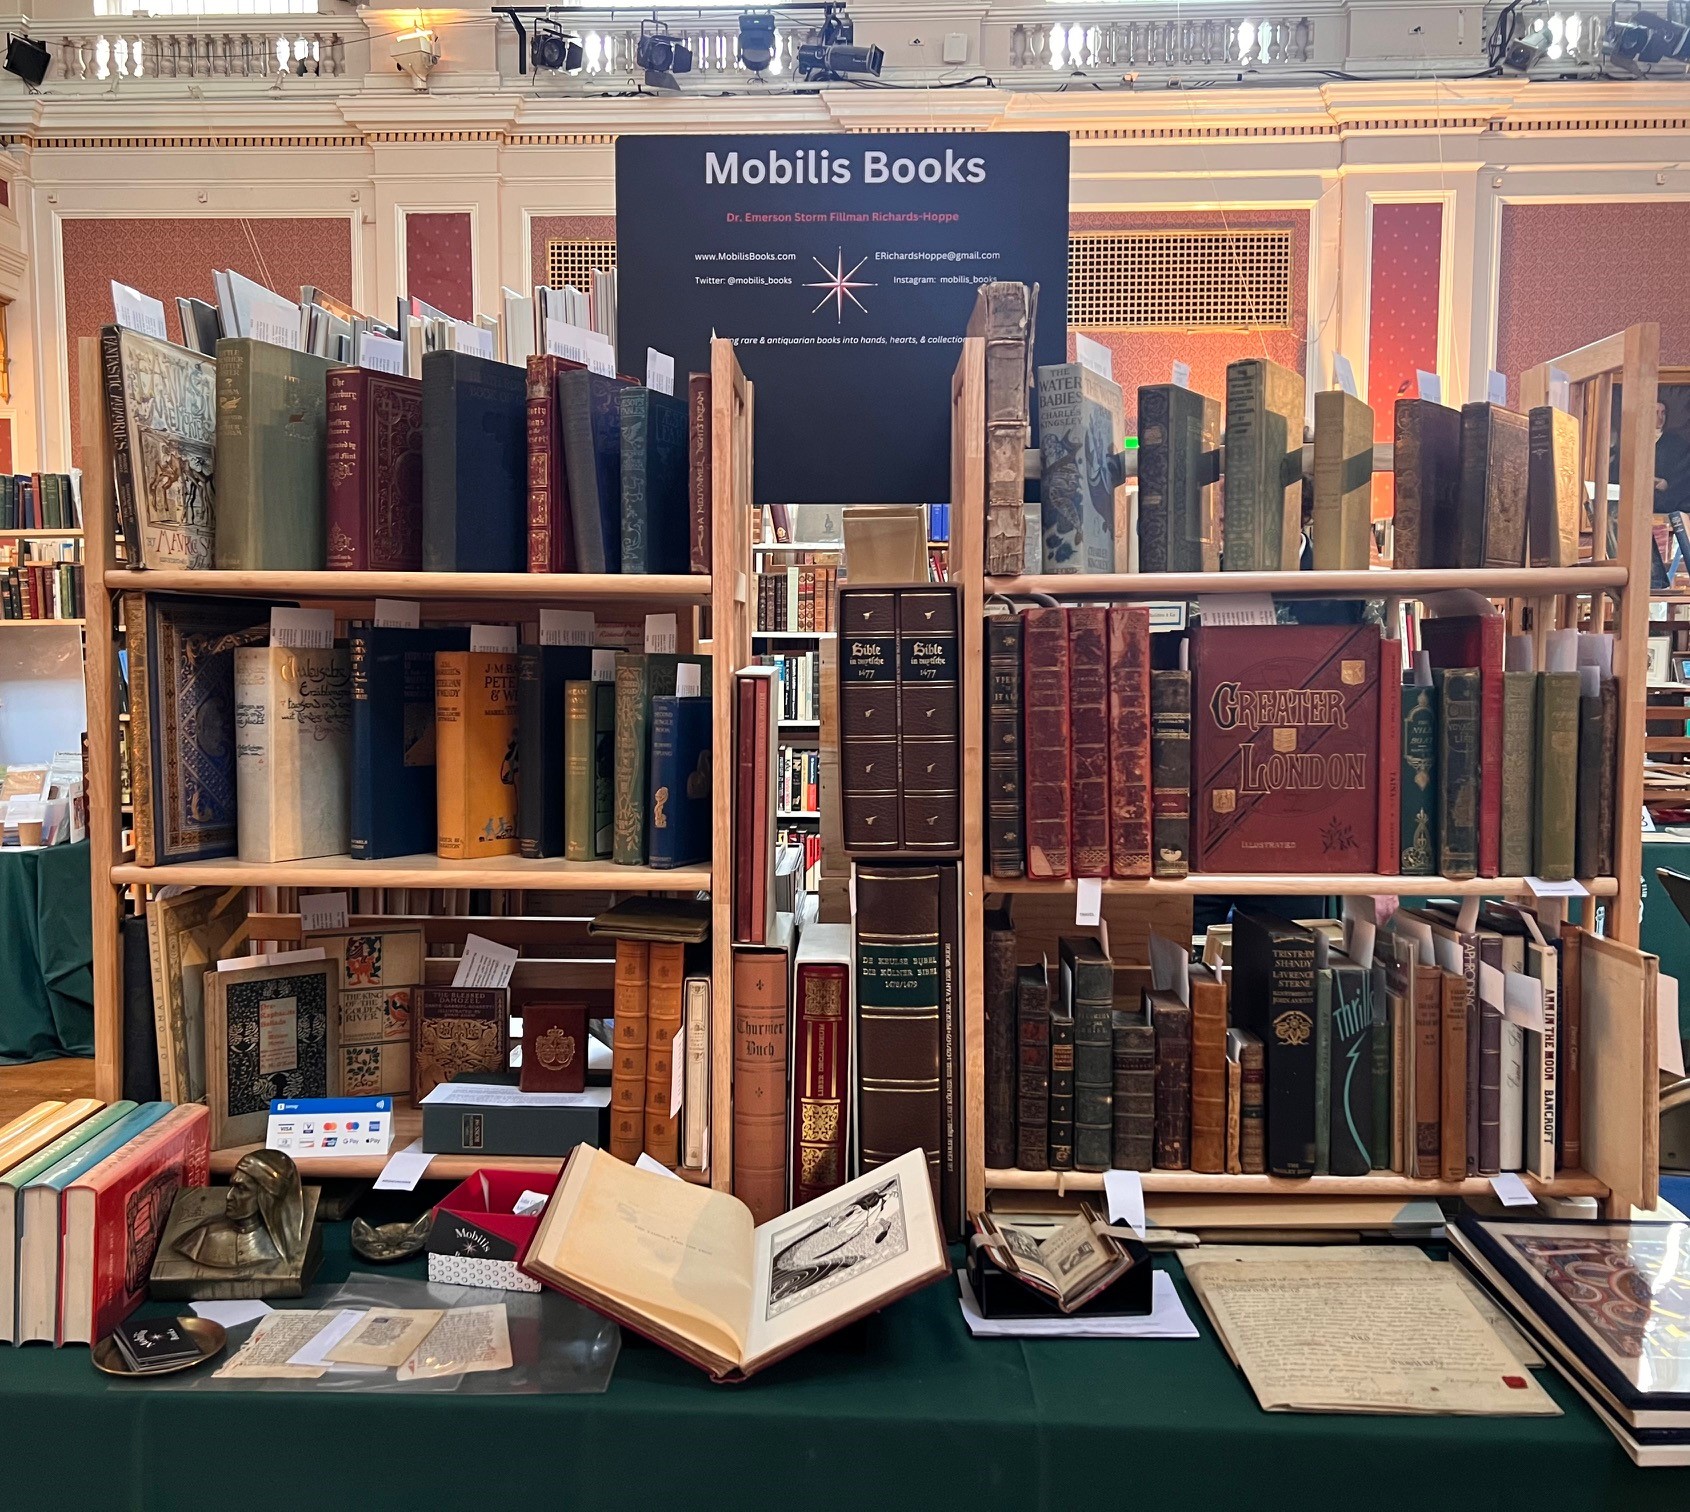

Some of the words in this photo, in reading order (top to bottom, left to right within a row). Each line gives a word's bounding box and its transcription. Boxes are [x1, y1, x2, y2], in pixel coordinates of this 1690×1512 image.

[705, 149, 851, 184] Mobilis
[864, 148, 986, 183] Books
[726, 212, 742, 222] Dr.
[745, 212, 792, 222] Emerson
[794, 212, 827, 222] Storm
[830, 212, 869, 222] Fillman
[872, 211, 959, 223] Richards-Hoppe
[695, 252, 796, 261] www.MobilisBooks.com
[875, 251, 1000, 262] ERichardsHoppe@gmail.com
[695, 276, 726, 284] Twitter:
[727, 276, 792, 286] @mobilis_books
[893, 276, 936, 286] Instagram:
[767, 336, 815, 346] antiquarian
[816, 336, 841, 344] books
[842, 336, 859, 344] into
[860, 336, 888, 346] hands,
[889, 336, 918, 345] hearts,
[920, 336, 926, 344] &
[103, 335, 122, 392] FANTASTIC
[1050, 368, 1070, 378] THE
[332, 377, 345, 387] The
[1040, 376, 1082, 394] WATER
[1040, 391, 1083, 409] BABIES
[696, 391, 705, 422] DREAM
[1041, 409, 1082, 420] CHARLES
[1040, 417, 1083, 429] KINGSLEY
[852, 642, 881, 656] Bible
[913, 641, 943, 656] Bible
[859, 669, 875, 678] 1477
[920, 669, 937, 678] 1477
[1209, 682, 1349, 732] GREATER
[1239, 743, 1367, 794] LONDON
[1241, 841, 1297, 849] ILLUSTRATED
[150, 919, 162, 984] KHAYYAM
[862, 956, 874, 964] DE
[862, 968, 877, 976] DIE
[880, 968, 914, 977] KÖLNER
[361, 992, 383, 1000] KING
[156, 994, 166, 1033] OMAR
[346, 1006, 383, 1015] GOLDEN
[346, 1012, 379, 1022] RIVER
[1545, 1026, 1555, 1047] THE
[746, 1040, 775, 1058] Buch
[1545, 1050, 1555, 1081] MOON
[1544, 1089, 1555, 1145] BANCROFT
[455, 1228, 491, 1253] Mobilis
